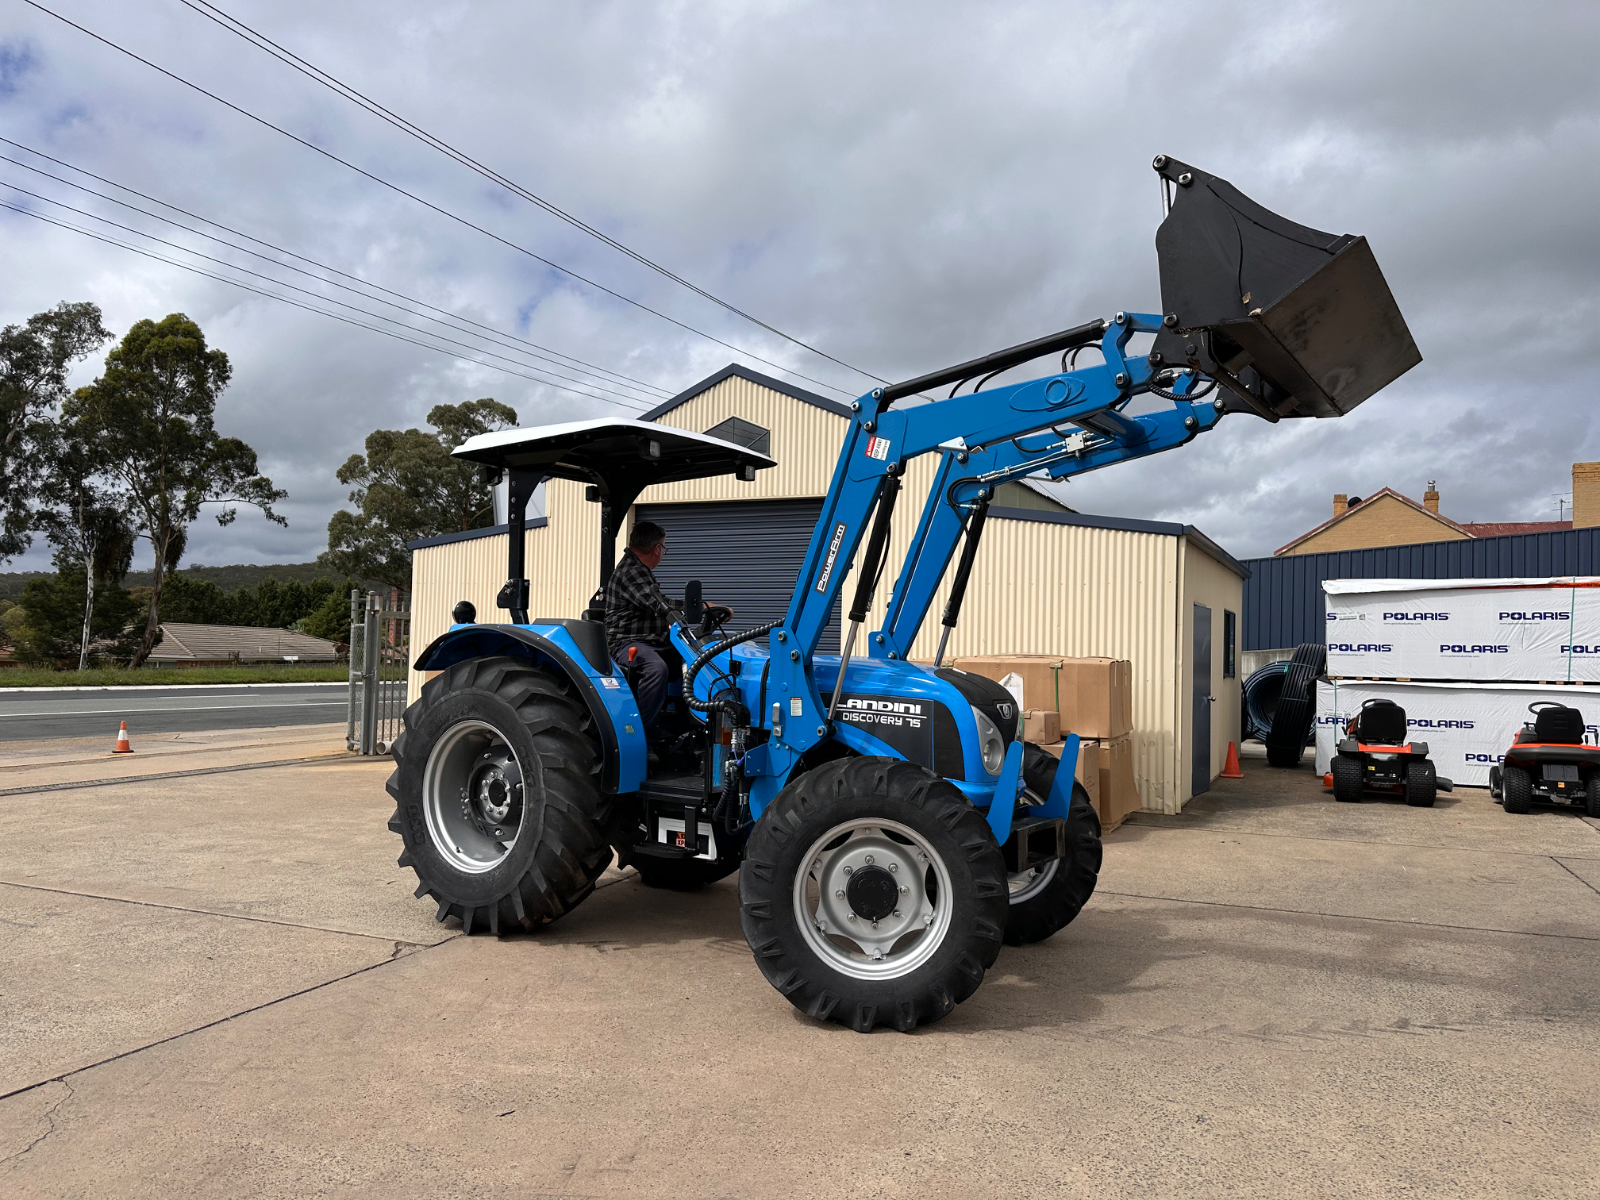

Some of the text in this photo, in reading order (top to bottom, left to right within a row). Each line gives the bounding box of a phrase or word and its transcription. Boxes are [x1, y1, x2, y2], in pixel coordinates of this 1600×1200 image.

[817, 524, 845, 592] PowerArm
[1383, 612, 1449, 620] POLARIS
[1499, 612, 1570, 620] POLARIS
[1440, 645, 1508, 653] POLARIS
[842, 712, 921, 728] DISCOVERY 75
[1407, 719, 1474, 728] POLARIS
